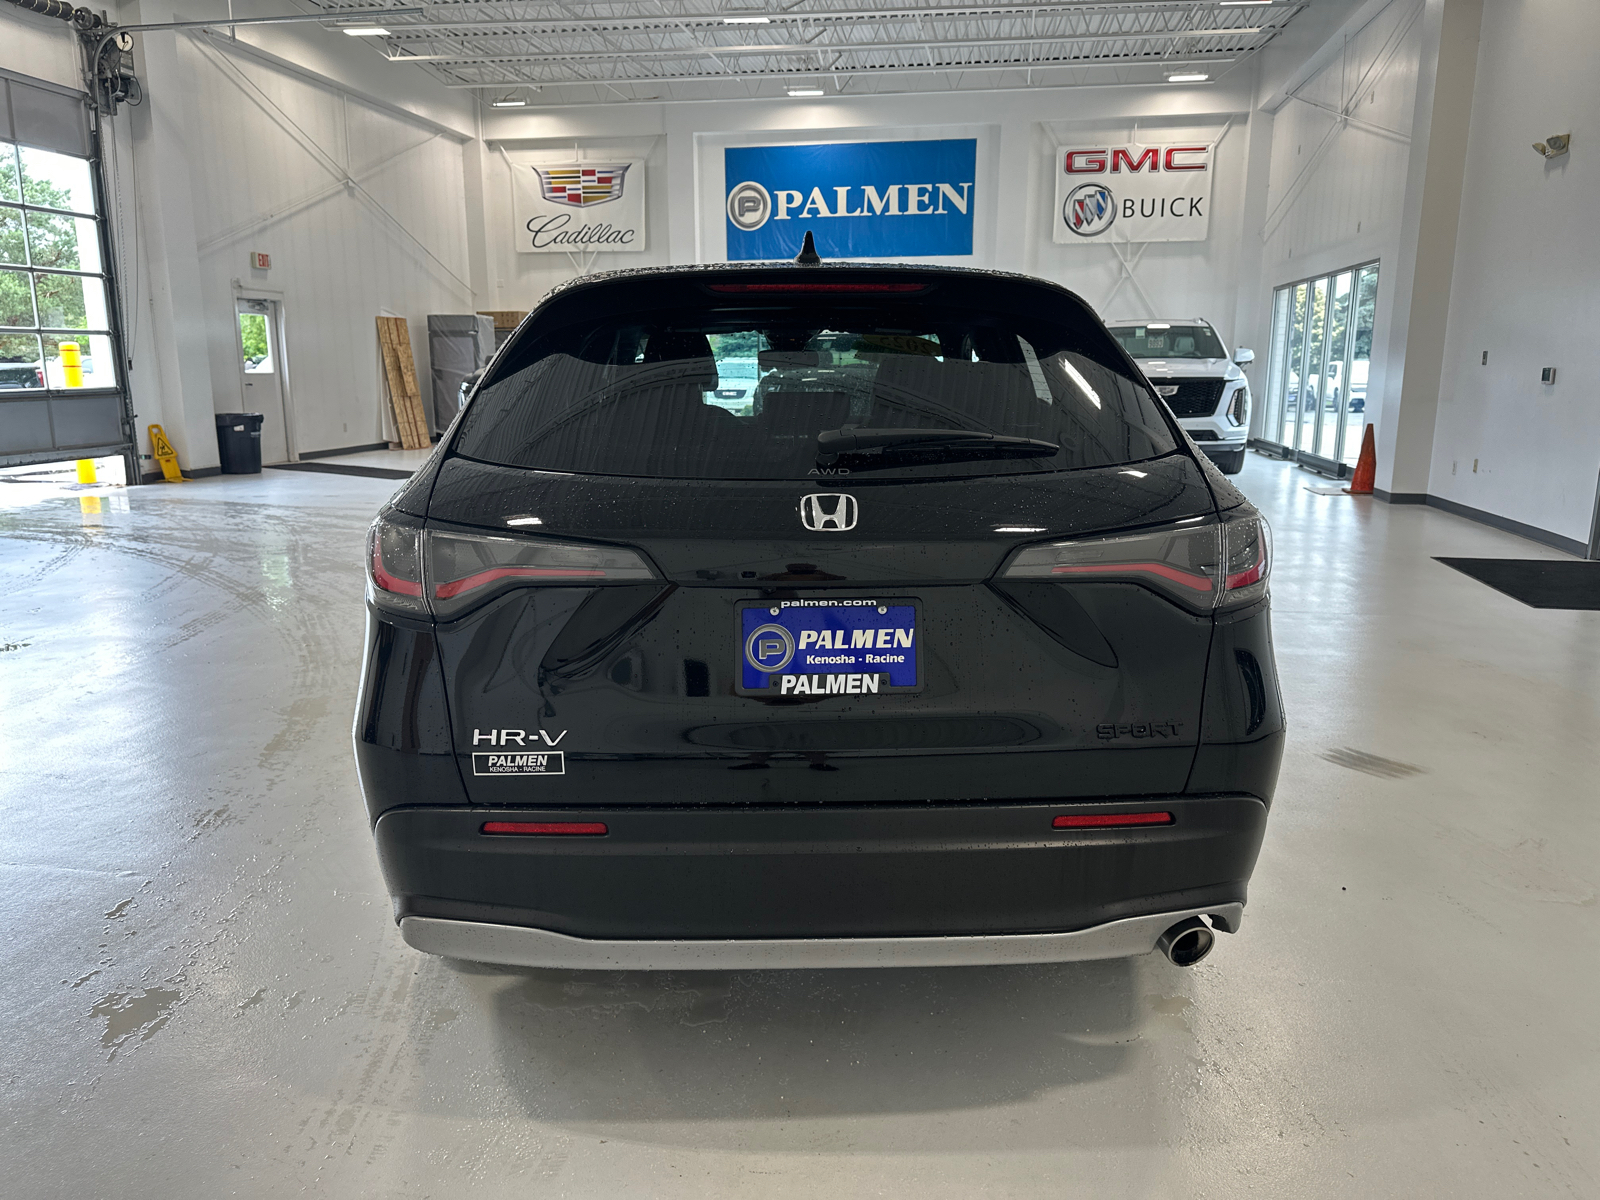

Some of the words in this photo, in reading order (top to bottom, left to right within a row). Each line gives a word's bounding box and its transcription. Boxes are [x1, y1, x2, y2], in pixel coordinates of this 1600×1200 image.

[1064, 145, 1210, 175] GMC
[773, 182, 973, 220] PALMEN
[1122, 197, 1204, 218] BUICK
[526, 213, 635, 248] Cadillac
[780, 599, 877, 608] palmen.com
[798, 628, 914, 650] PALMEN
[806, 654, 855, 665] Kenosha
[865, 653, 905, 664] Racine
[780, 673, 880, 695] PALMEN
[472, 728, 568, 746] HR-V
[1096, 722, 1184, 740] SPORT
[488, 754, 548, 767] PALMEN
